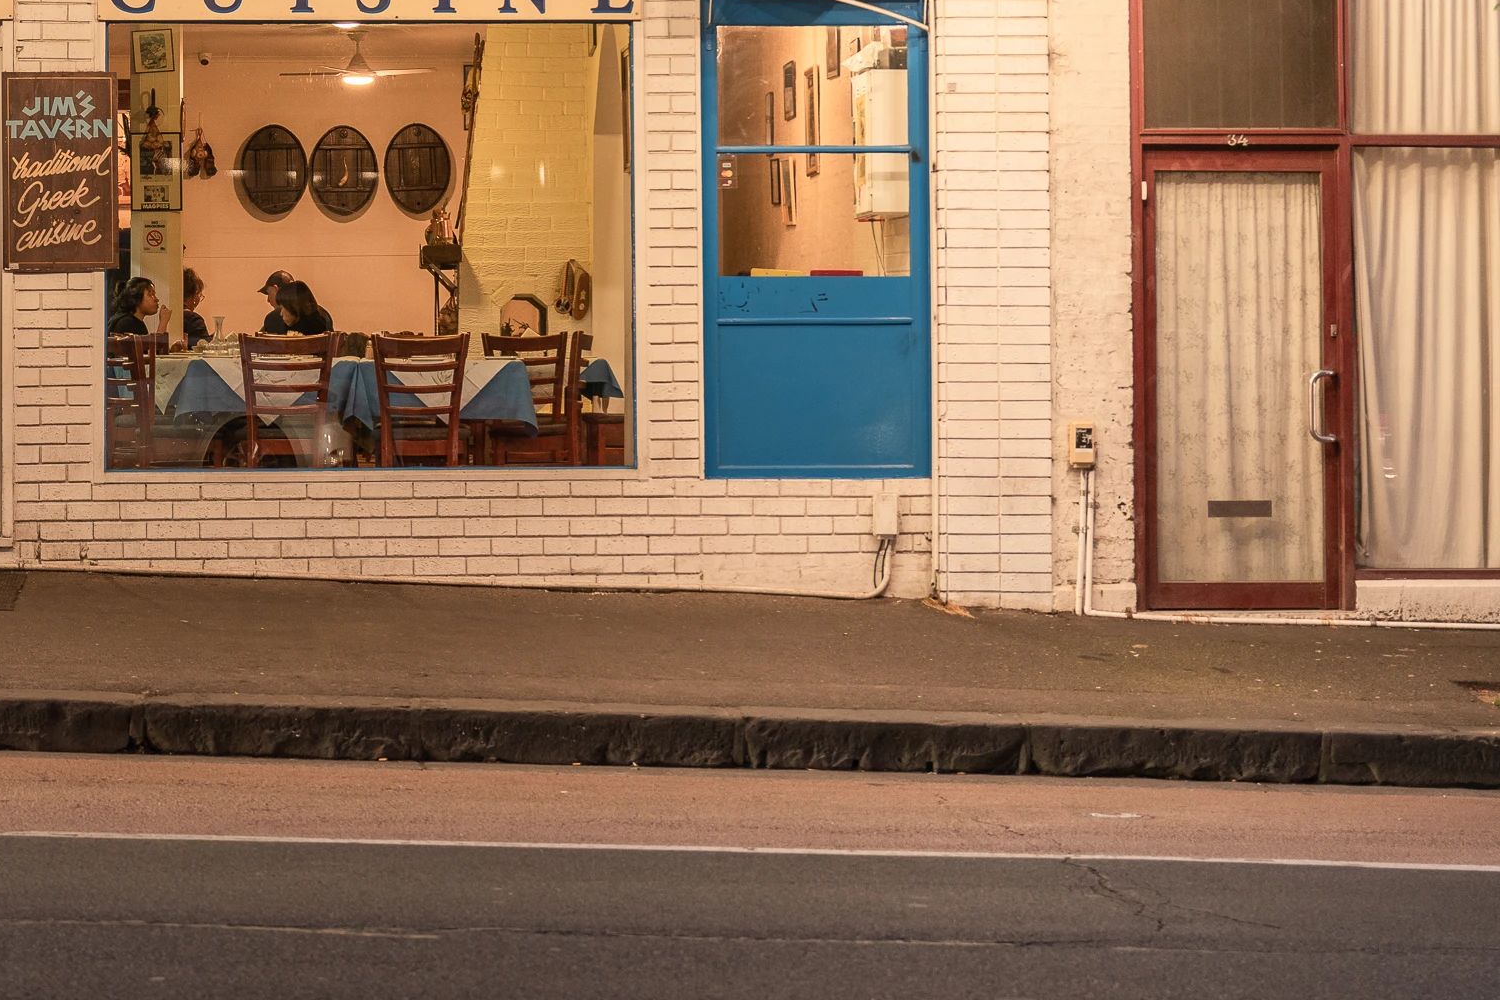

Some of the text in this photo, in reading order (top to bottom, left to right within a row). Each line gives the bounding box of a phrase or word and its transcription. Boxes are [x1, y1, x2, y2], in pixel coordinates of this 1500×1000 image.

[22, 89, 96, 118] JIM'S
[6, 118, 113, 141] TAVERN
[1227, 134, 1248, 146] 34
[12, 146, 112, 181] traditional
[12, 178, 101, 228] Greek
[16, 219, 102, 252] cuisine
